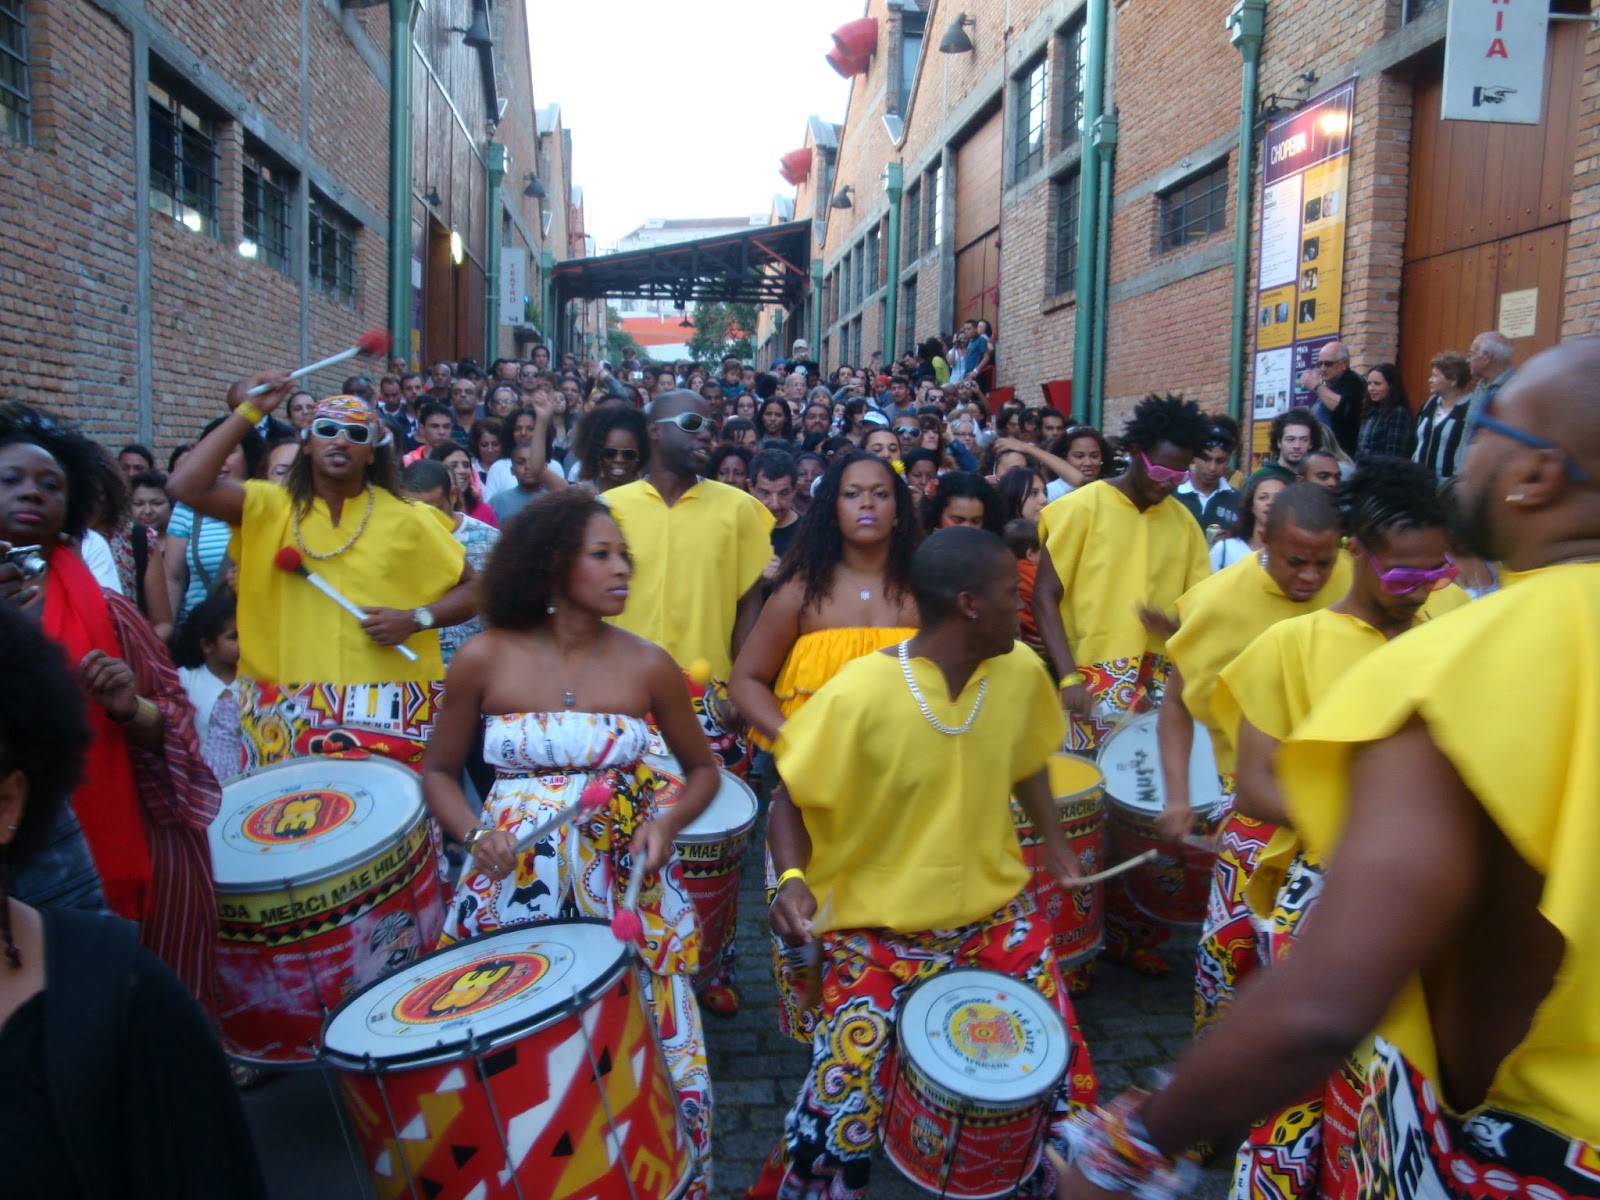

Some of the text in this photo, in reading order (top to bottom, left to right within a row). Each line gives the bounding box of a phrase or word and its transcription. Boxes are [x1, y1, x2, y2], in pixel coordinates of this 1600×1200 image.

[1486, 0, 1510, 59] IA
[1060, 799, 1096, 819] RACIAS
[260, 893, 327, 924] MERCI
